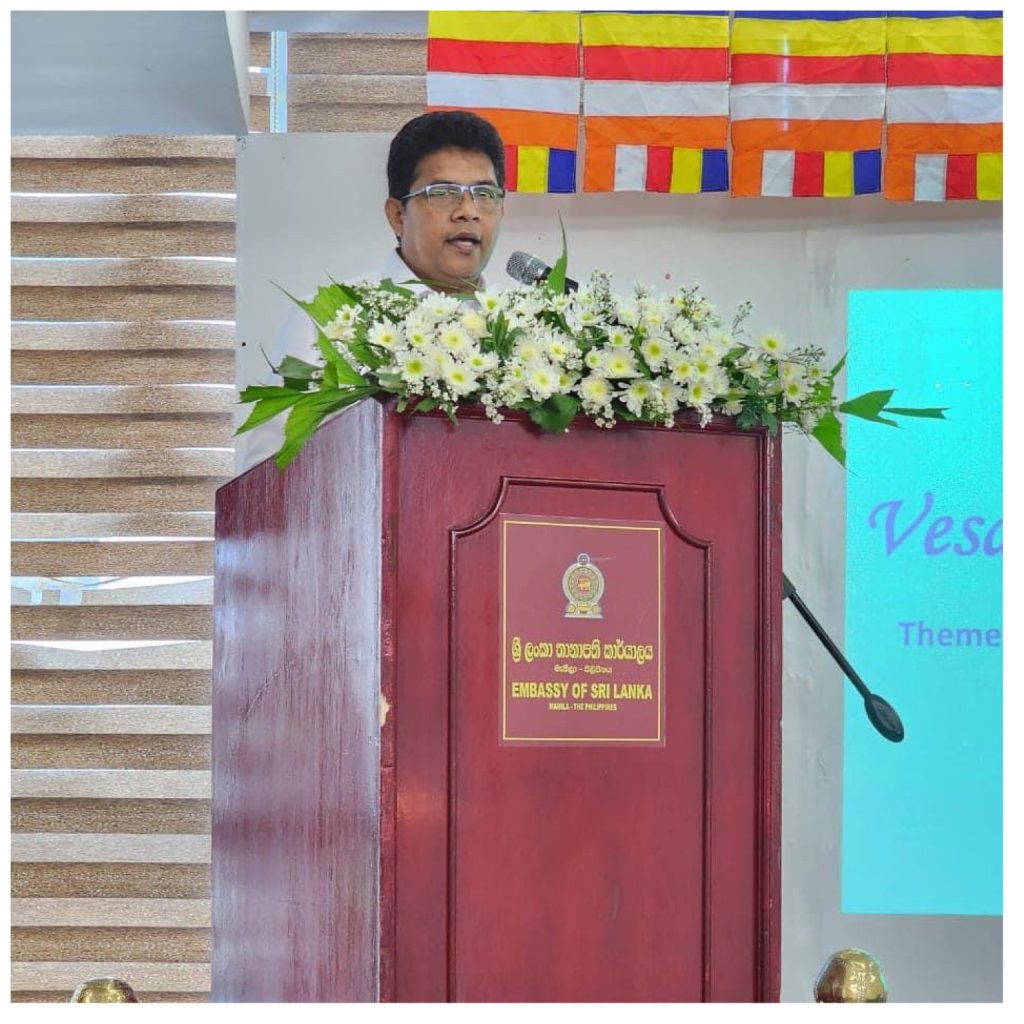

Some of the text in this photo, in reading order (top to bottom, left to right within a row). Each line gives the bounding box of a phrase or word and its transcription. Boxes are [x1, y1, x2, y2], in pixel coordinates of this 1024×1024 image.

[898, 621, 1002, 647] Theme
[511, 682, 653, 700] EMBASSY OF SRI LANKA
